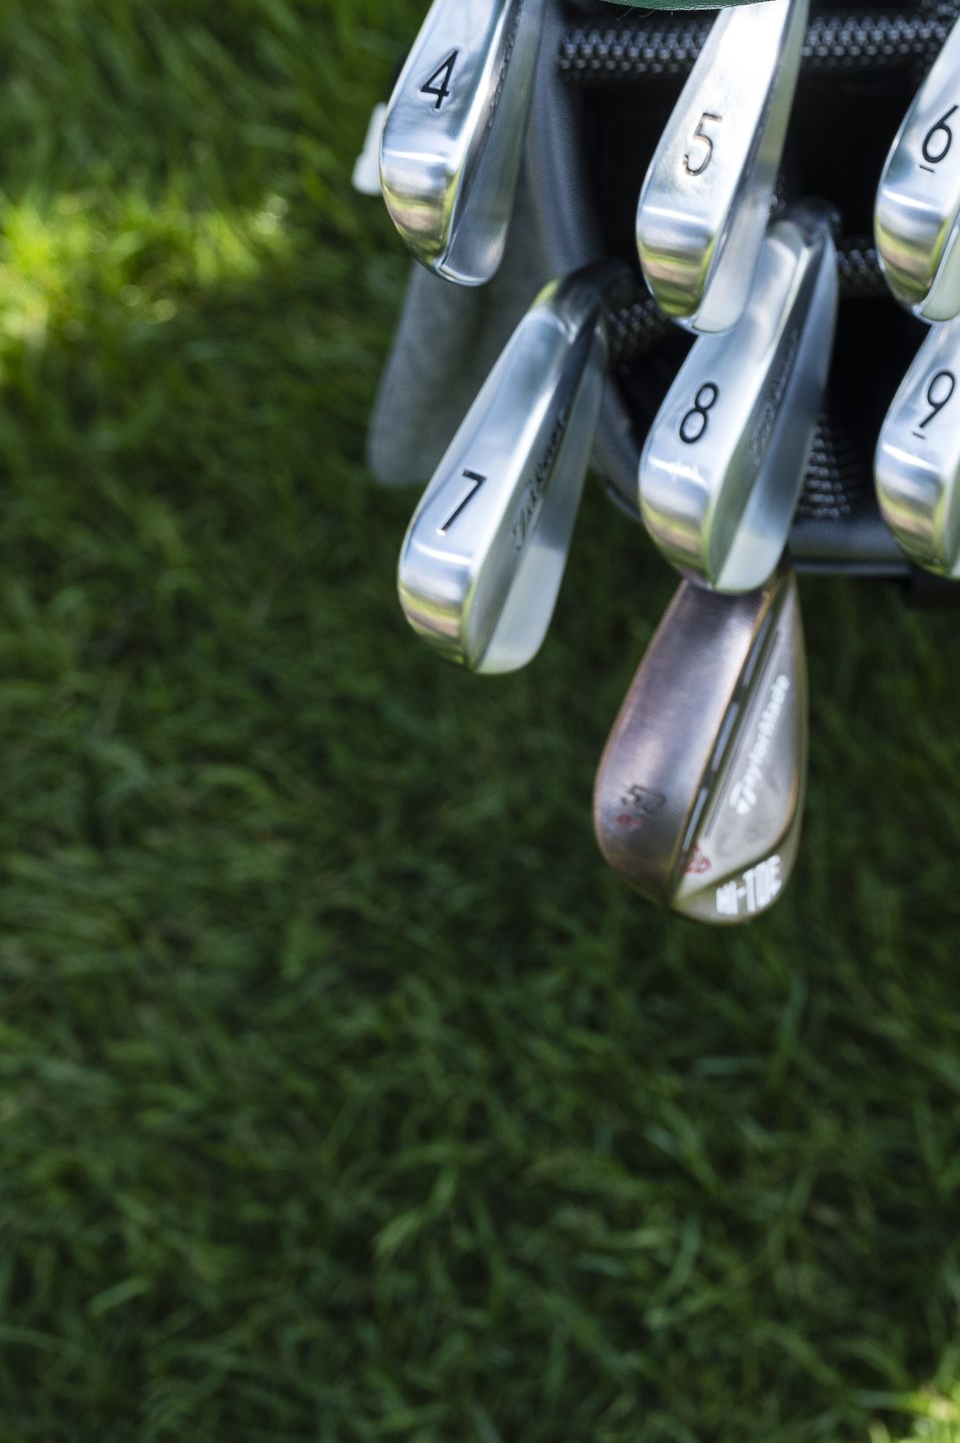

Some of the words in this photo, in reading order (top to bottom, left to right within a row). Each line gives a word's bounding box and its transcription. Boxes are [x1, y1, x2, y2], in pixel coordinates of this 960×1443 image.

[419, 47, 460, 110] 4
[681, 111, 723, 177] 5
[920, 104, 960, 164] 6
[678, 380, 720, 445] 8
[917, 369, 956, 430] 9
[437, 468, 487, 536] 7
